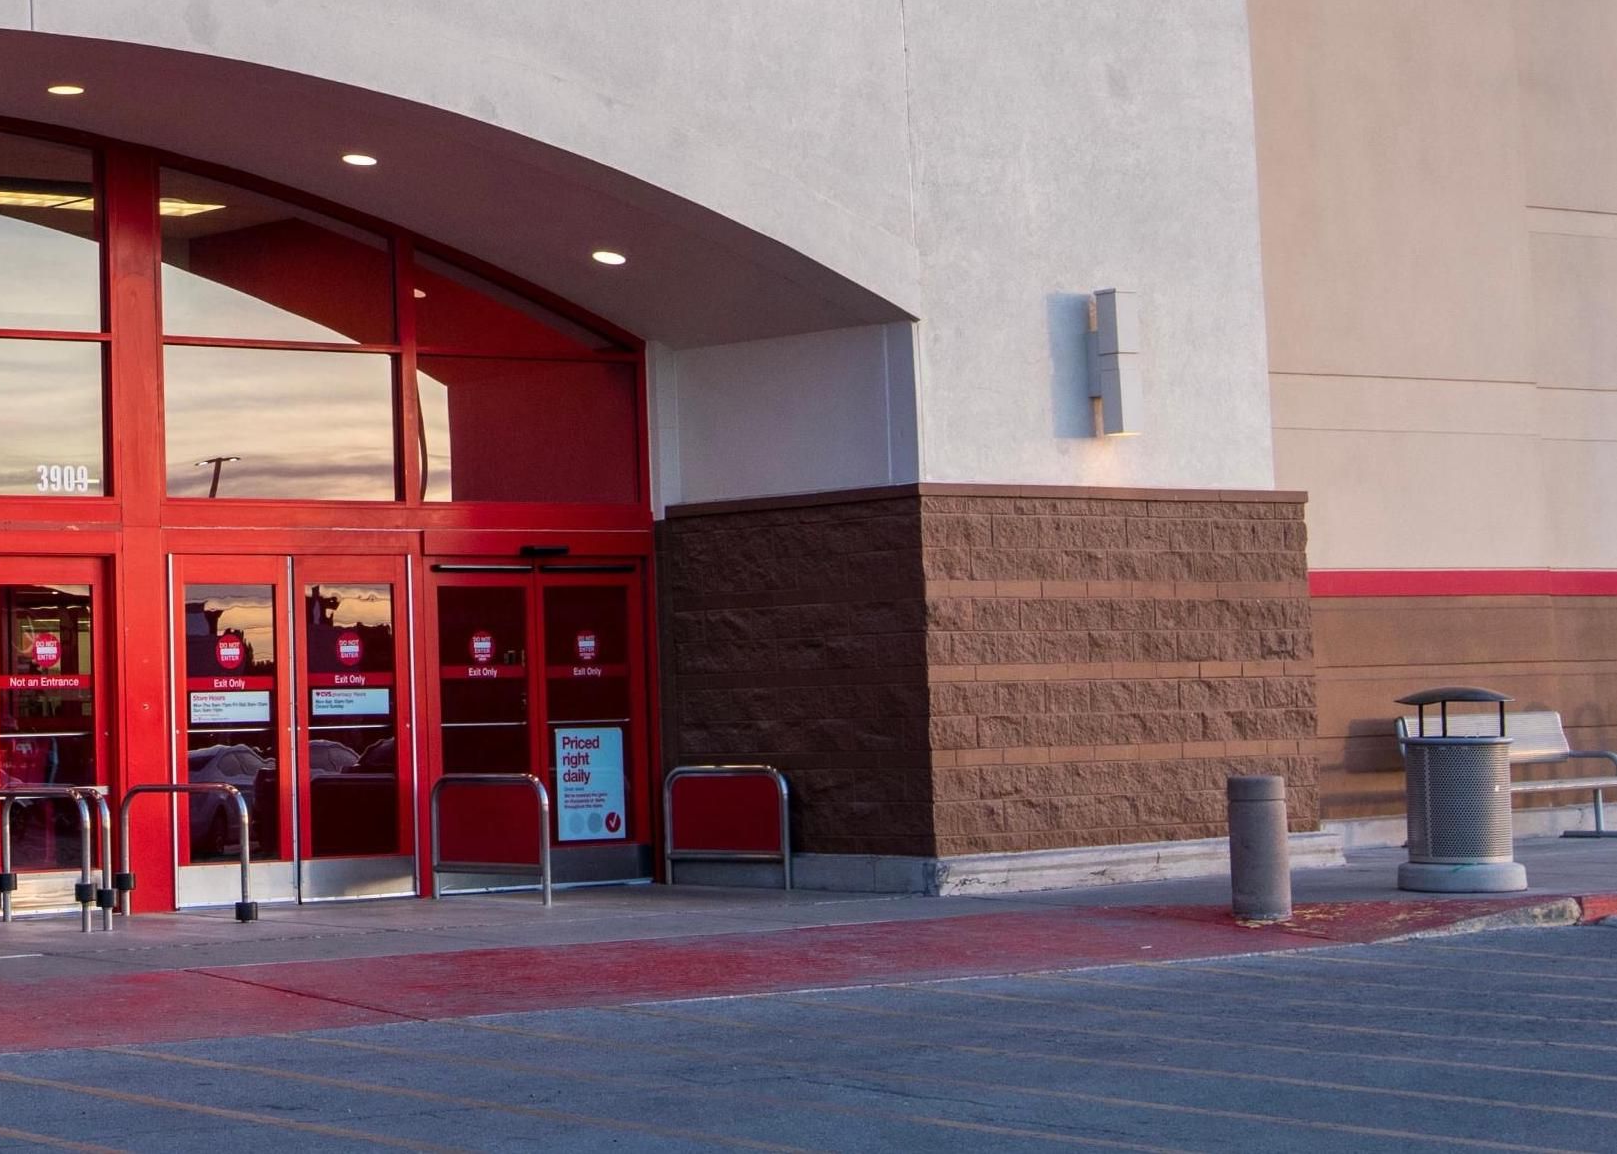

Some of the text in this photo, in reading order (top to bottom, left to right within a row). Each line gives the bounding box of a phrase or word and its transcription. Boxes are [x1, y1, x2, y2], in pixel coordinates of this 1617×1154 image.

[36, 464, 88, 492] 3909
[468, 667, 497, 678] Exit Only
[573, 667, 601, 677] Exit Only
[9, 678, 25, 686] Not
[40, 677, 79, 686] Entrance
[213, 678, 246, 690] Exit Only
[334, 674, 366, 685] Exit Only
[562, 735, 600, 750] Priced
[562, 752, 590, 768] right
[562, 769, 591, 785] daily
